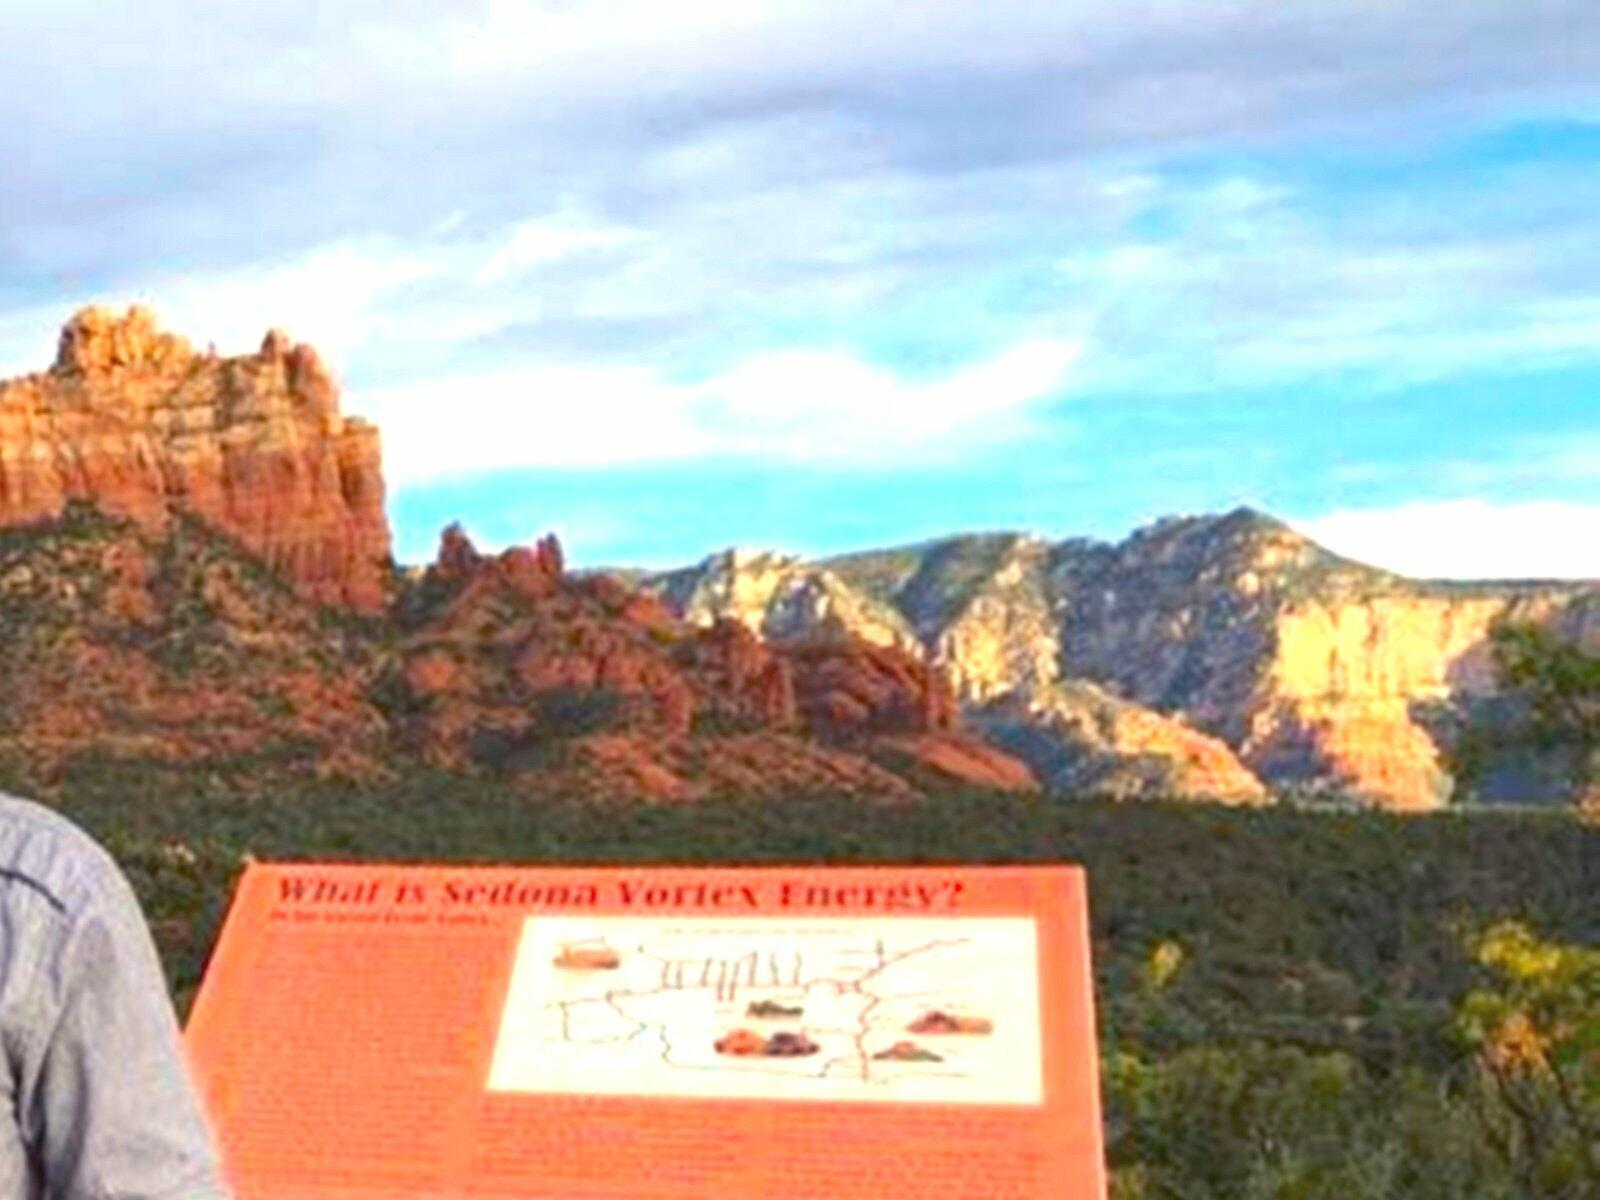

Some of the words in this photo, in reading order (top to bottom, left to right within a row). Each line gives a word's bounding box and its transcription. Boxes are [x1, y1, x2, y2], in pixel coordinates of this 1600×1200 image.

[277, 878, 380, 904] What
[394, 882, 425, 904] is
[442, 879, 598, 907] Sedona
[616, 880, 760, 908] Vortex
[779, 881, 964, 912] Energy?
